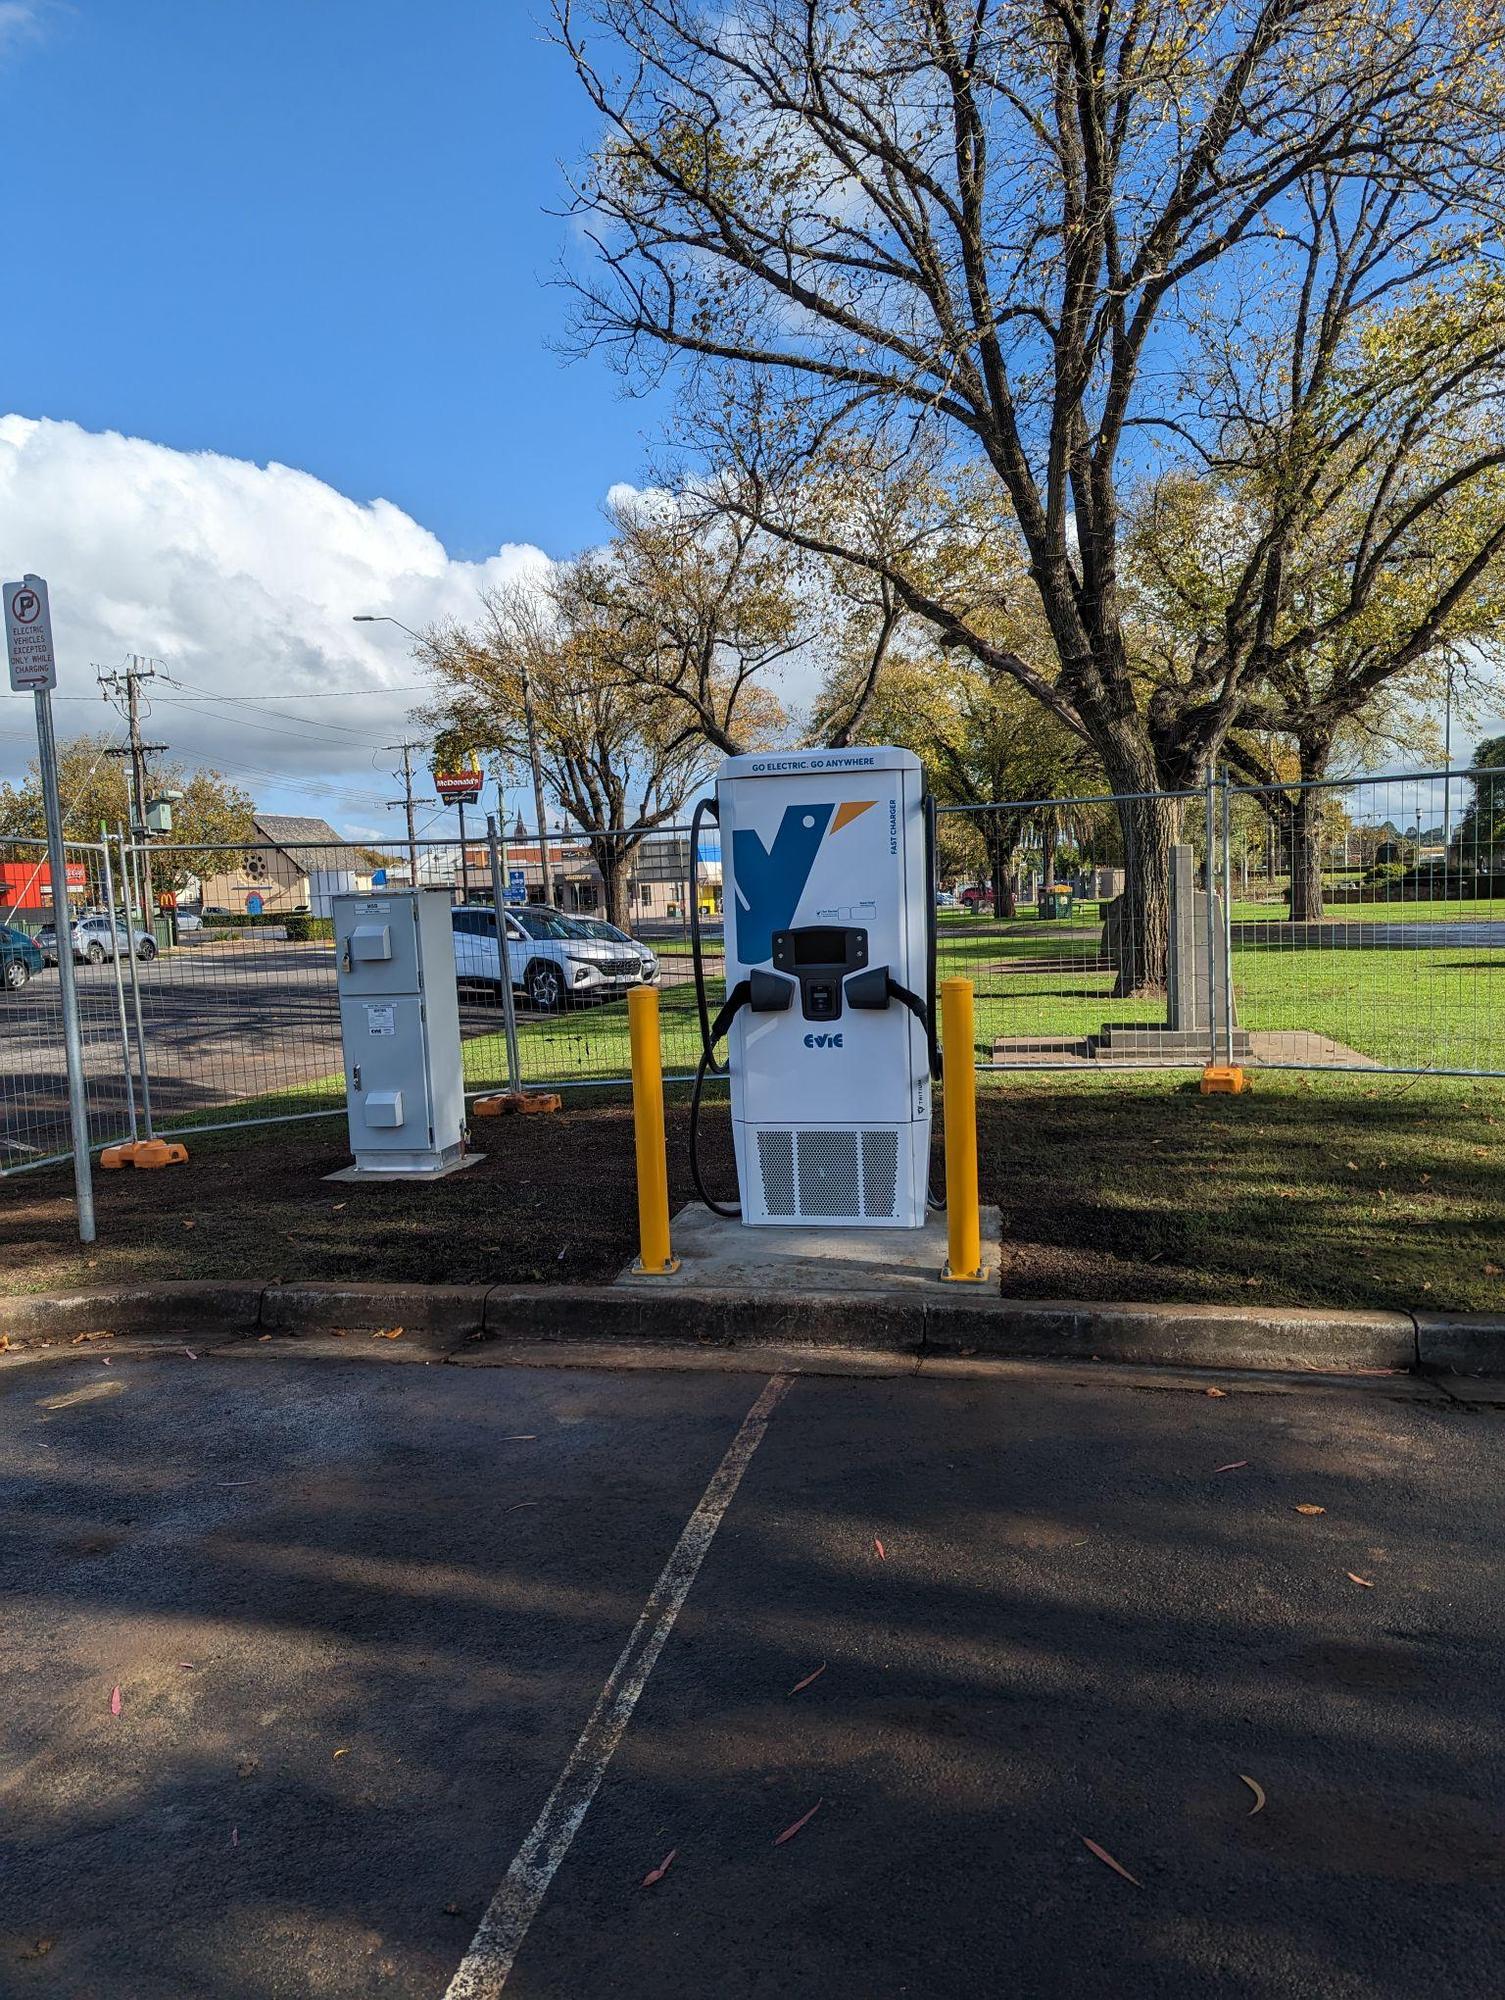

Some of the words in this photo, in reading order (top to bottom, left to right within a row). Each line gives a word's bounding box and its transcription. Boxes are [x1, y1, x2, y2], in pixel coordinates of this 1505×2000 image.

[13, 626, 44, 636] ELECTRIC
[13, 635, 45, 645] VEHICLES
[13, 645, 47, 655] EXCEPTED
[11, 656, 29, 664] ONLY
[32, 654, 52, 663] WHILE
[15, 664, 49, 674] CHARGING
[752, 764, 765, 772] GO
[767, 761, 809, 771] ELECTRIC.
[810, 760, 824, 768] GO
[825, 757, 875, 767] ANYWHERE
[436, 778, 479, 787] McDonald's
[889, 799, 897, 835] CHARGER
